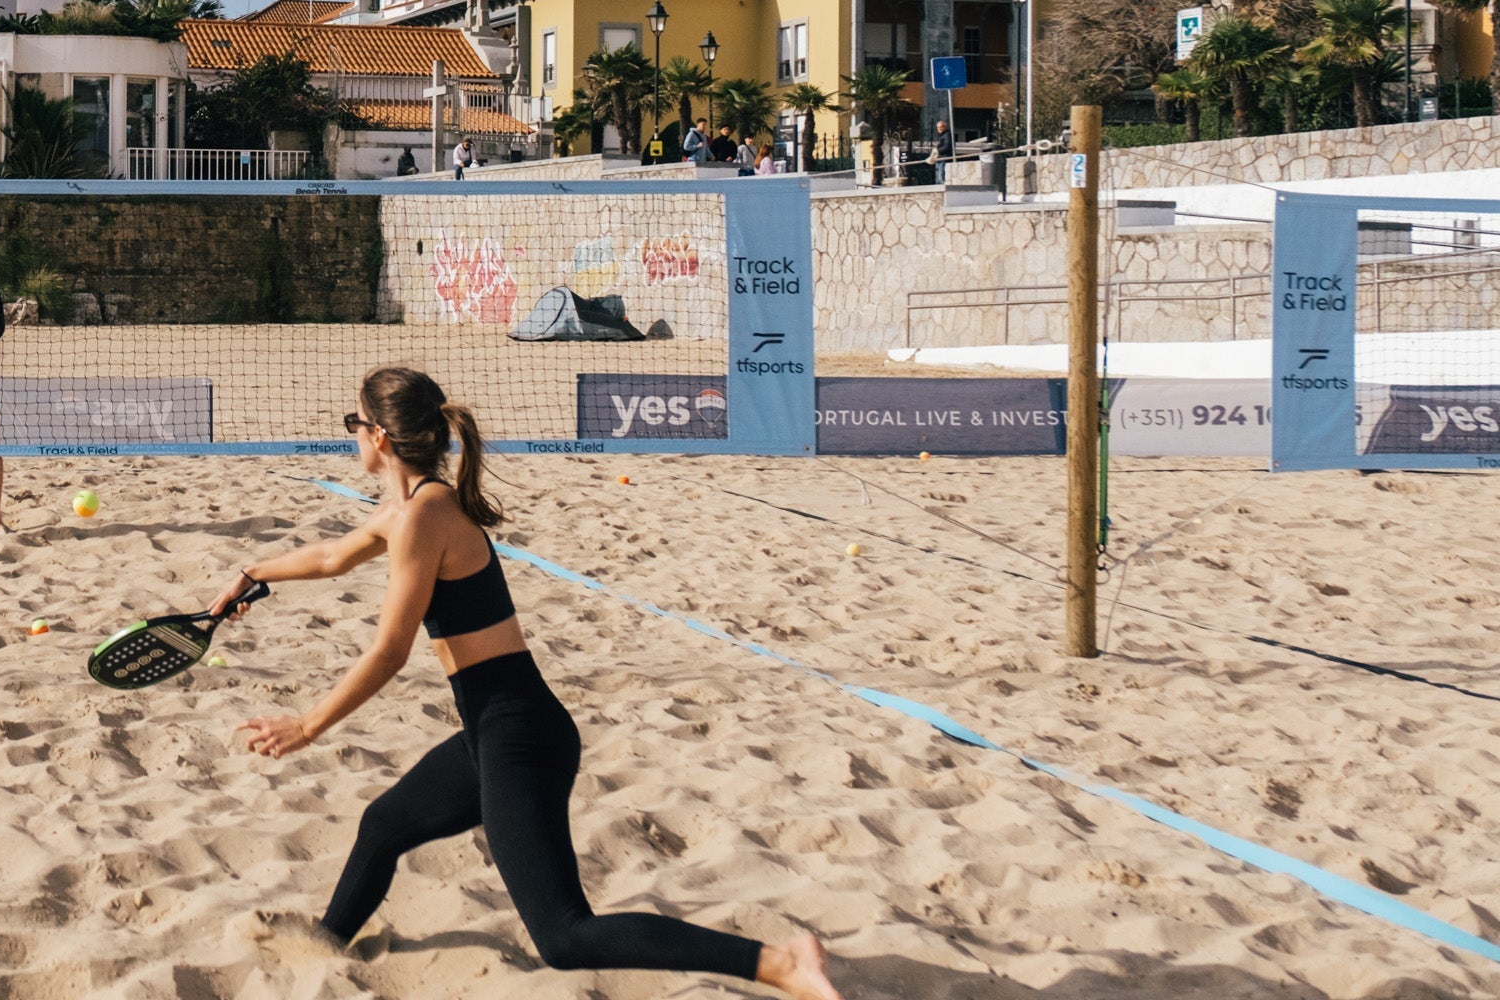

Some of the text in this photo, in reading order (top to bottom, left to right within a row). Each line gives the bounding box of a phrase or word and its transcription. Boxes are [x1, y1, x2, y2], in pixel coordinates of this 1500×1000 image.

[1073, 155, 1084, 172] 2
[322, 187, 348, 195] Tennis
[733, 256, 795, 274] Track
[734, 277, 800, 294] & Field
[1282, 271, 1342, 291] Track
[1282, 293, 1347, 311] & Field
[736, 357, 804, 376] tfsports
[1282, 374, 1349, 392] tfsports
[611, 395, 691, 437] yes
[814, 410, 1069, 426] ORTUGAL LIVE & INVEST
[1120, 408, 1184, 430] (+351)
[1192, 405, 1247, 426] 924
[1418, 404, 1499, 441] yes
[87, 446, 118, 455] Field
[310, 442, 353, 454] tfsports
[526, 441, 604, 453] Track & Field
[1476, 456, 1500, 468] Tra
